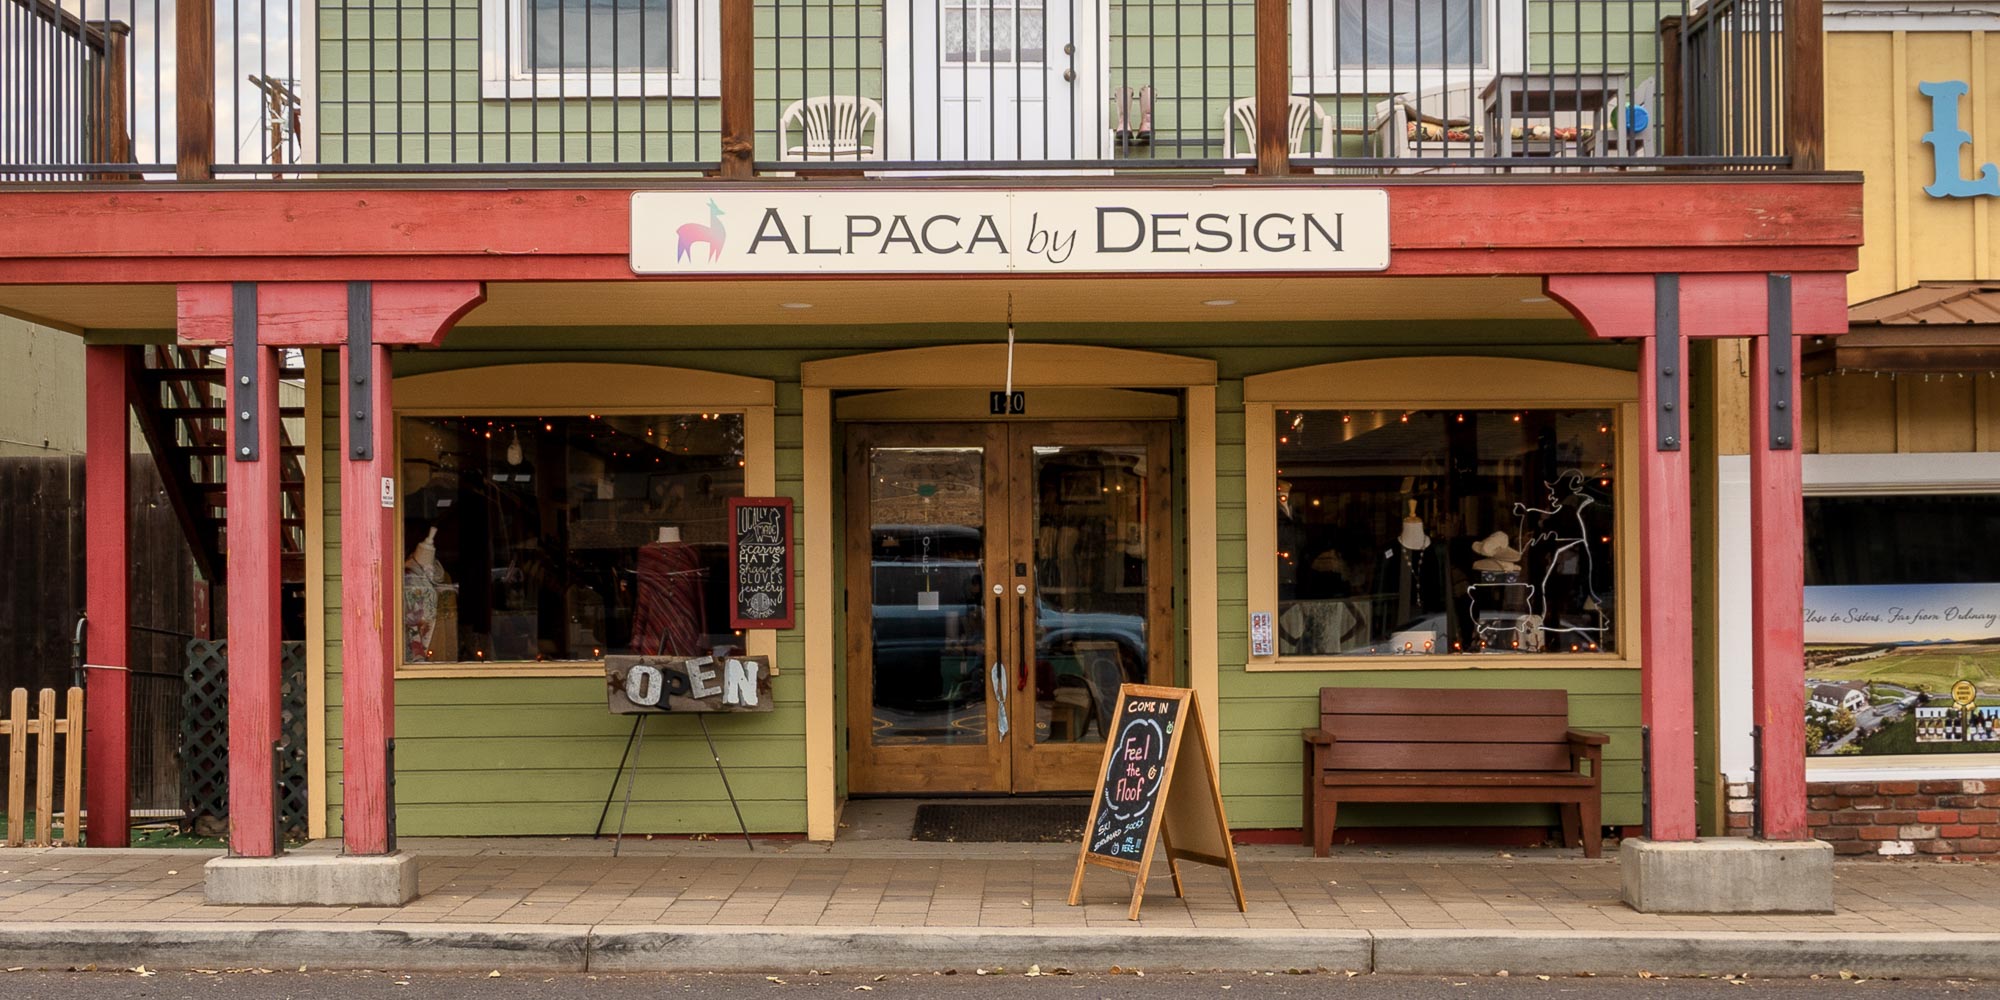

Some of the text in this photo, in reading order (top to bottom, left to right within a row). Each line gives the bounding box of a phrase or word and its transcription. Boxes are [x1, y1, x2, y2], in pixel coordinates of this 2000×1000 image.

[746, 207, 1344, 264] ALPACA by DESIGN
[737, 507, 768, 535] LOCALLY
[739, 553, 780, 563] HATS
[740, 573, 783, 584] GLOVES
[738, 581, 785, 604] jewelry
[1830, 612, 1841, 622] to
[1887, 606, 1910, 624] Far
[1908, 608, 1940, 625] from
[625, 656, 758, 710] OPEN
[1128, 701, 1169, 714] COME IN
[1124, 734, 1151, 761] Feel
[1126, 763, 1141, 777] the
[1115, 777, 1145, 802] Floof
